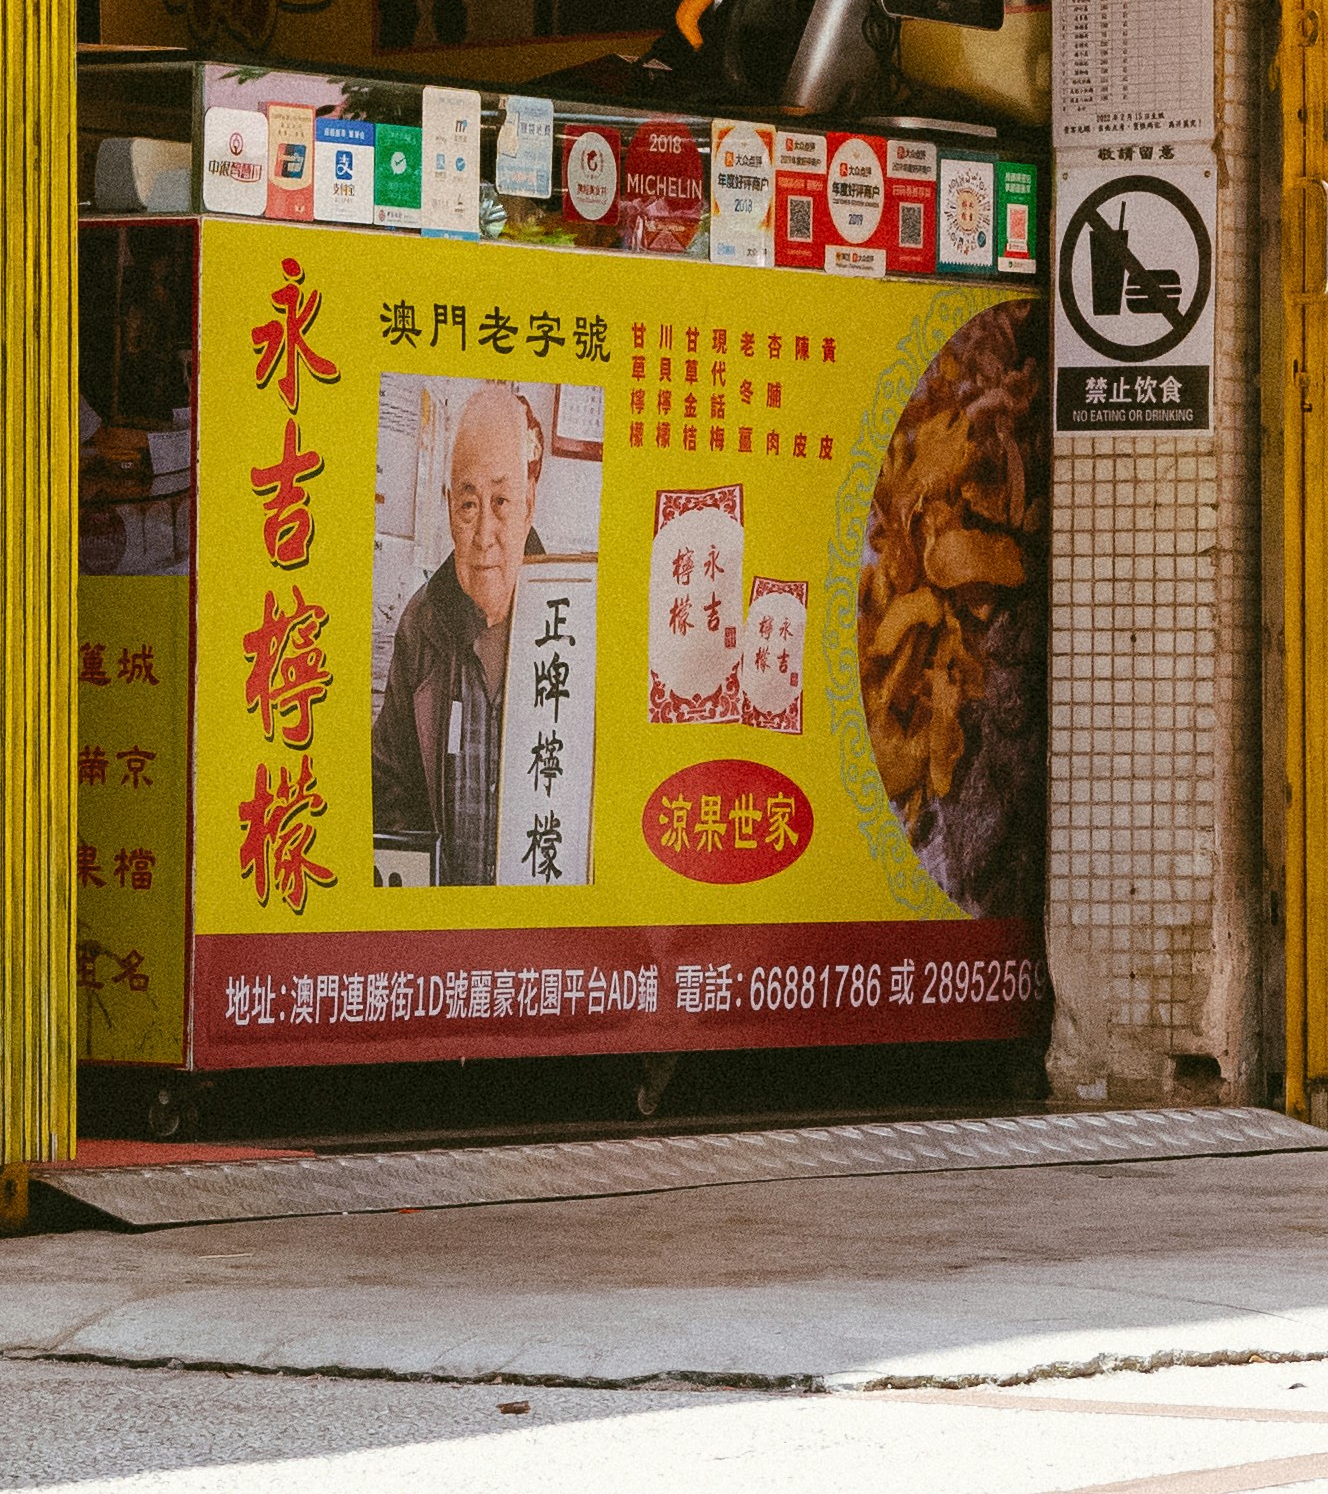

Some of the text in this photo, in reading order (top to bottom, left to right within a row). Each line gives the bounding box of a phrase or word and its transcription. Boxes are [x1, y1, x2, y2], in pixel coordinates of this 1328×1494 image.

[648, 133, 682, 154] 2018
[627, 173, 703, 200] MICHELIN
[717, 173, 769, 192] 年度好评商户
[832, 182, 880, 199] 年度好评商户
[380, 299, 612, 363] 澳門老字號
[1085, 375, 1183, 404] 禁止饮食
[1072, 409, 1194, 423] NO EATING OR DRINKING
[239, 257, 340, 917] 永吉檸檬
[525, 595, 575, 881] 正牌檸檬
[657, 790, 800, 857] 涼果世家
[888, 958, 916, 1006] 或
